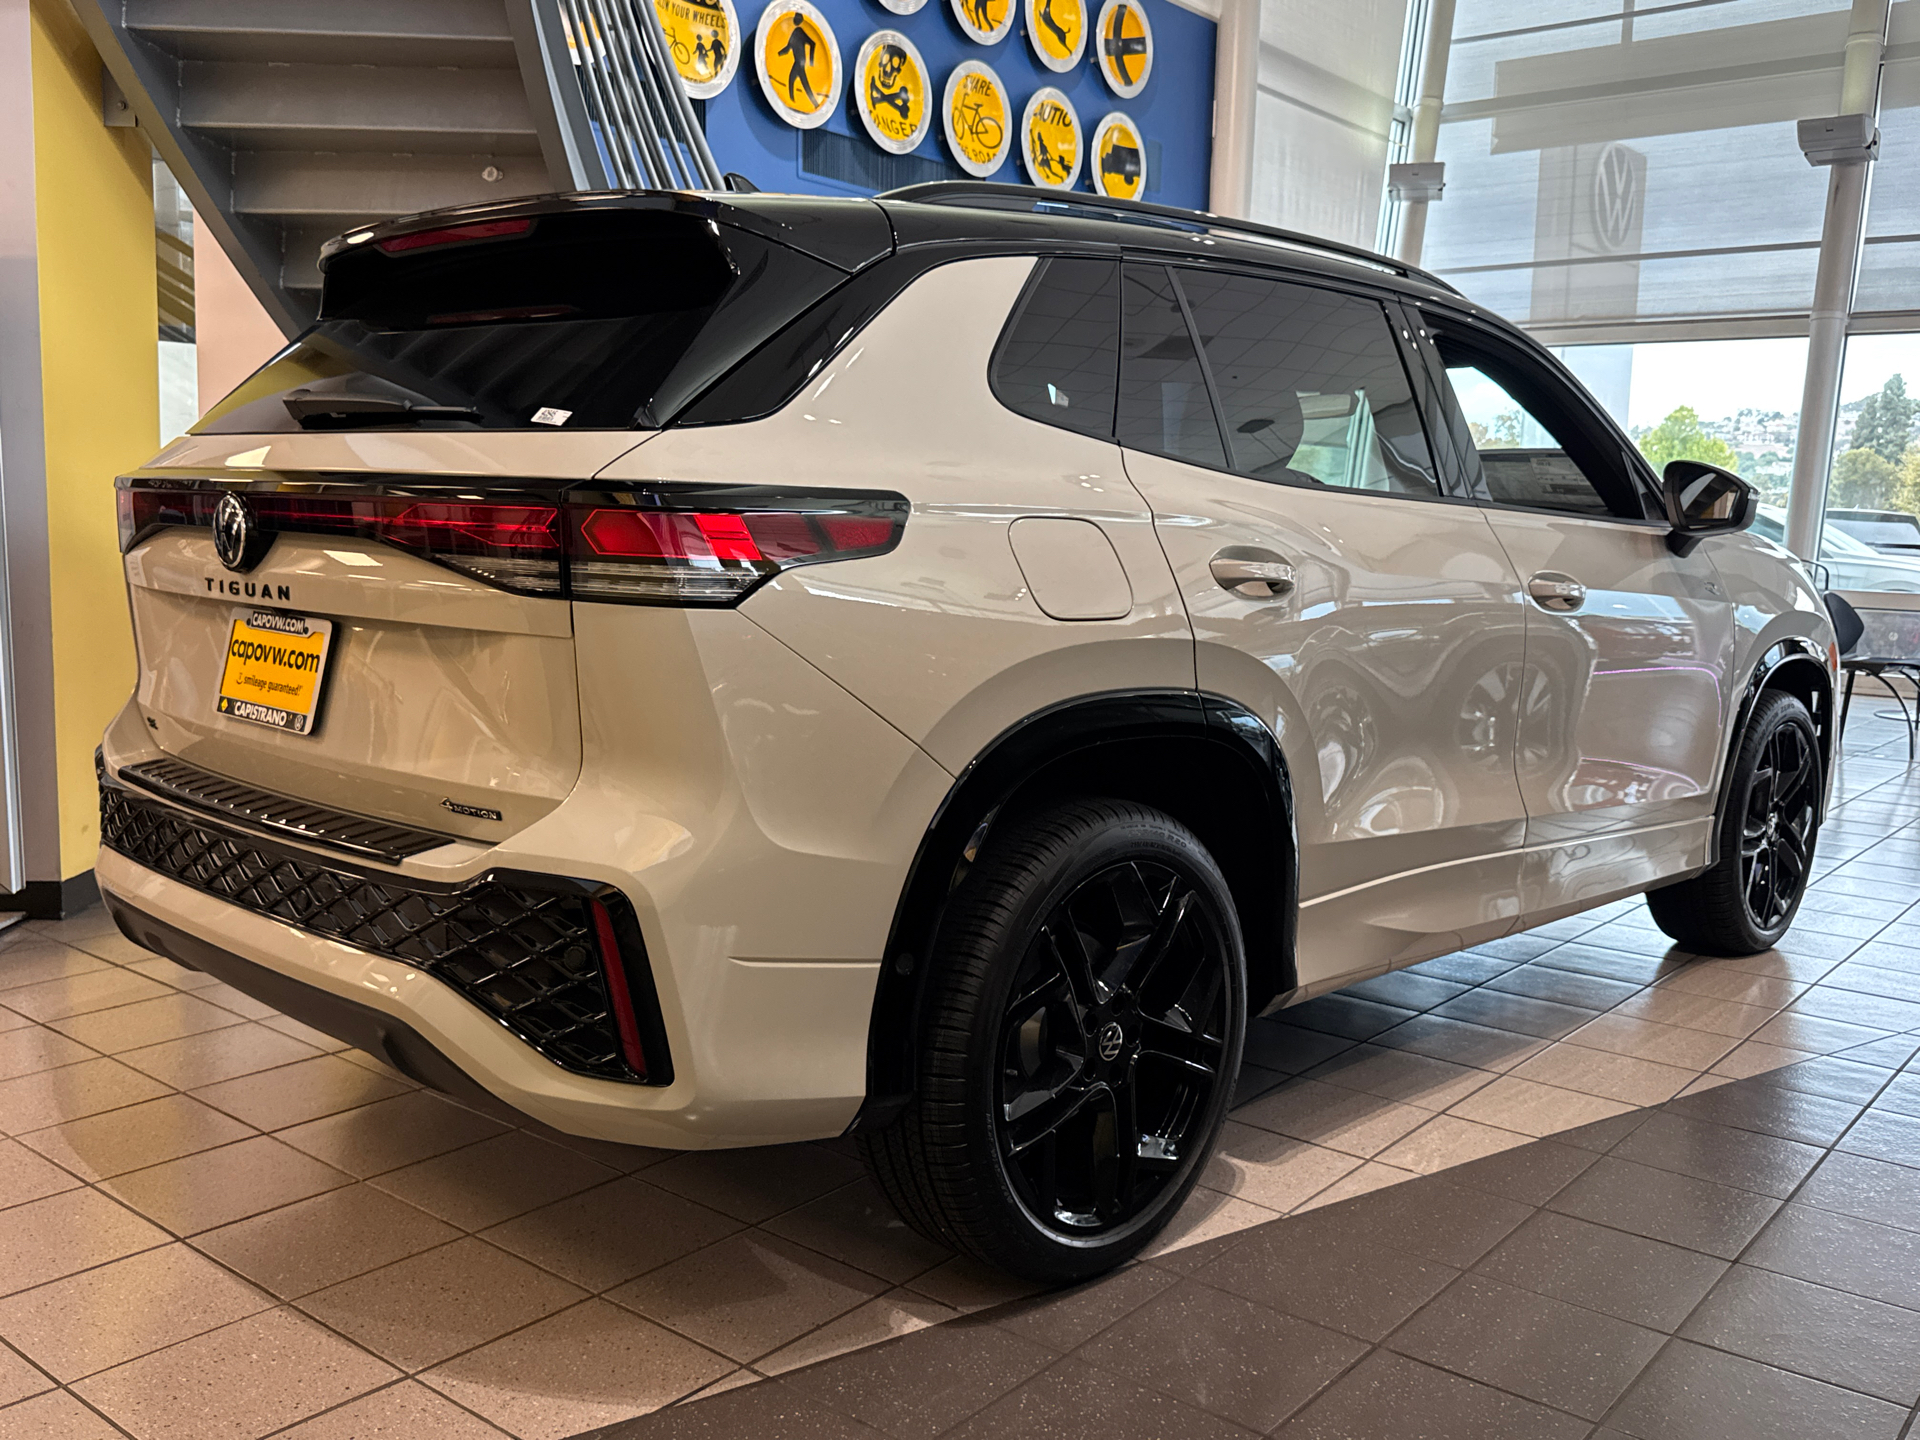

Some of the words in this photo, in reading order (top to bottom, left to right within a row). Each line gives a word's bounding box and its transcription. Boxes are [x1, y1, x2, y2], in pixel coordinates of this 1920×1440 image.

[672, 3, 690, 20] YOUR
[693, 10, 726, 29] WHEELS
[964, 75, 992, 97] SHARE
[205, 577, 291, 601] TIGUAN
[252, 612, 305, 634] CAPOVW.COM
[231, 638, 320, 673] capovw.com
[234, 701, 287, 727] CAPISTRANO
[439, 796, 497, 820] 4MOTION
